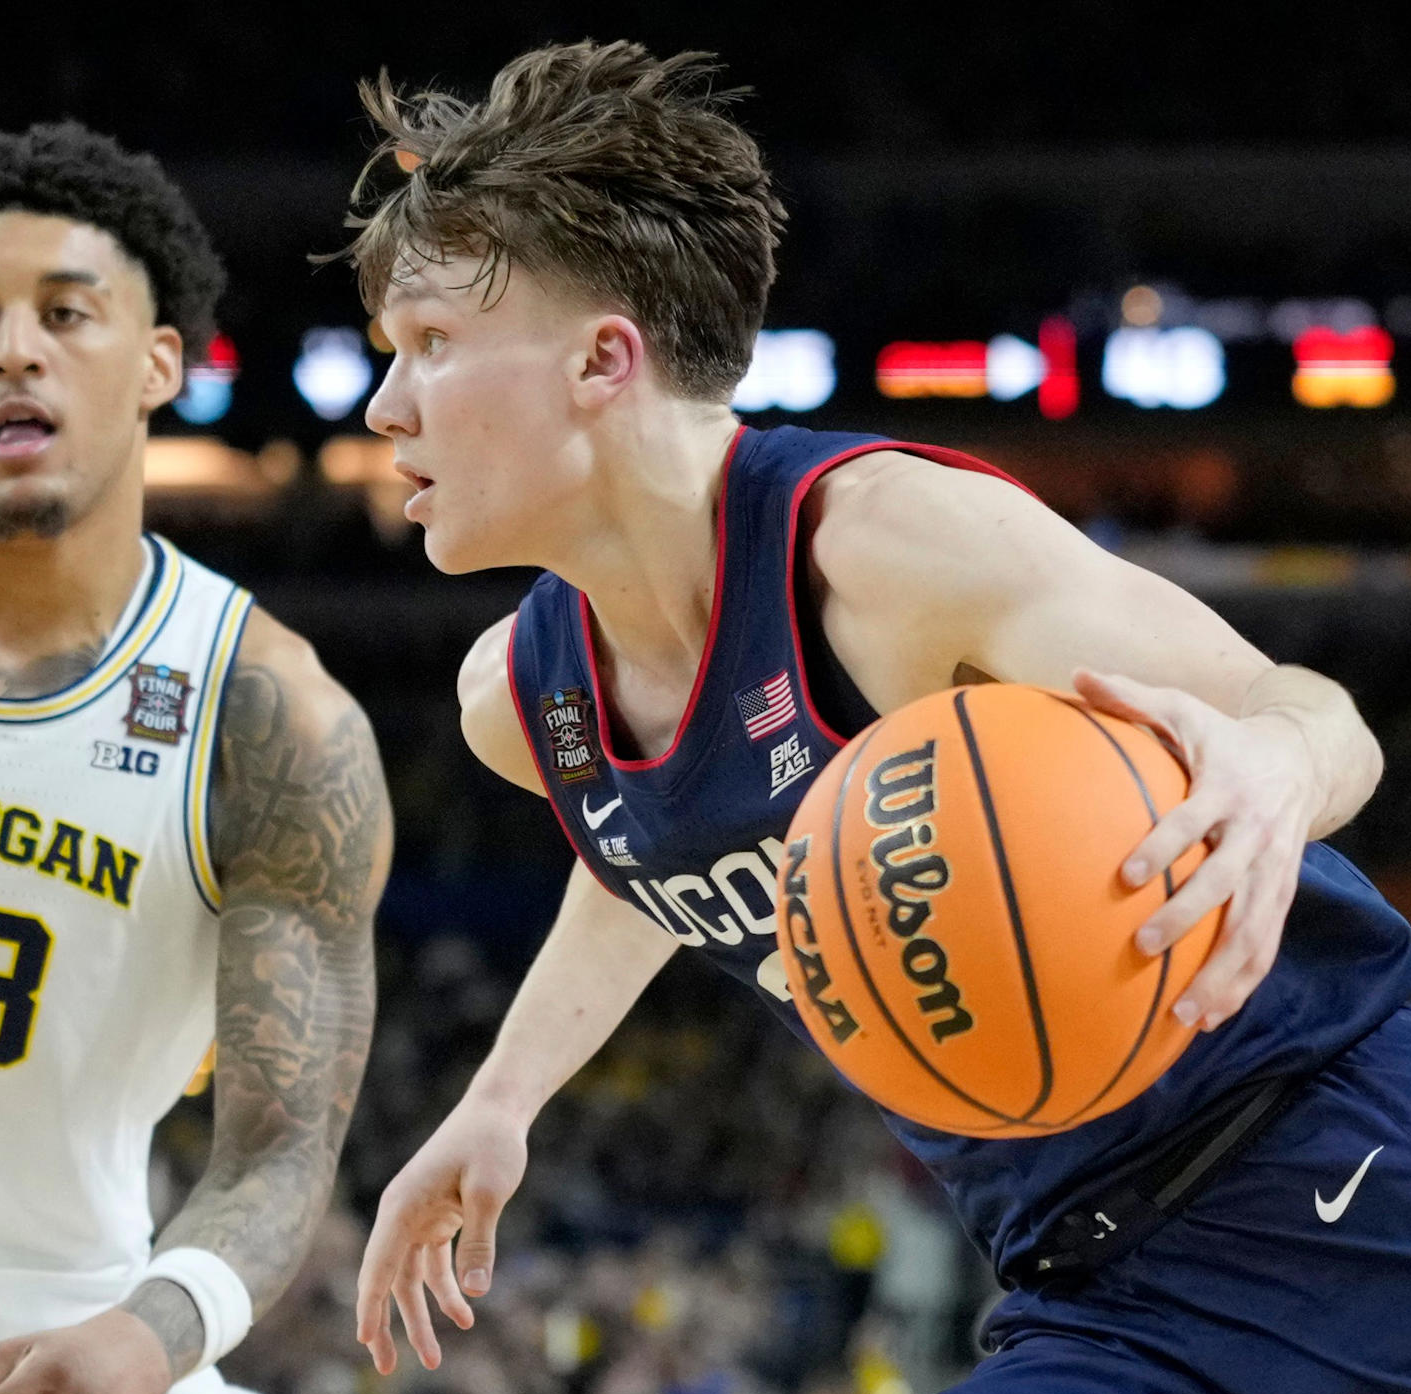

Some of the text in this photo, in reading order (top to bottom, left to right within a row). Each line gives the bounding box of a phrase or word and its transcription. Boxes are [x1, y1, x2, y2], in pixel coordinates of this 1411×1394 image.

[137, 676, 184, 700] FINAL
[133, 708, 179, 732] FOUR
[545, 706, 582, 730] FINAL
[556, 745, 591, 769] FOUR
[770, 732, 799, 769] BIG
[771, 746, 811, 788] EAST
[599, 836, 629, 856] BE THE
[864, 738, 975, 1046] Wilson
[784, 833, 860, 1045] NCAA
